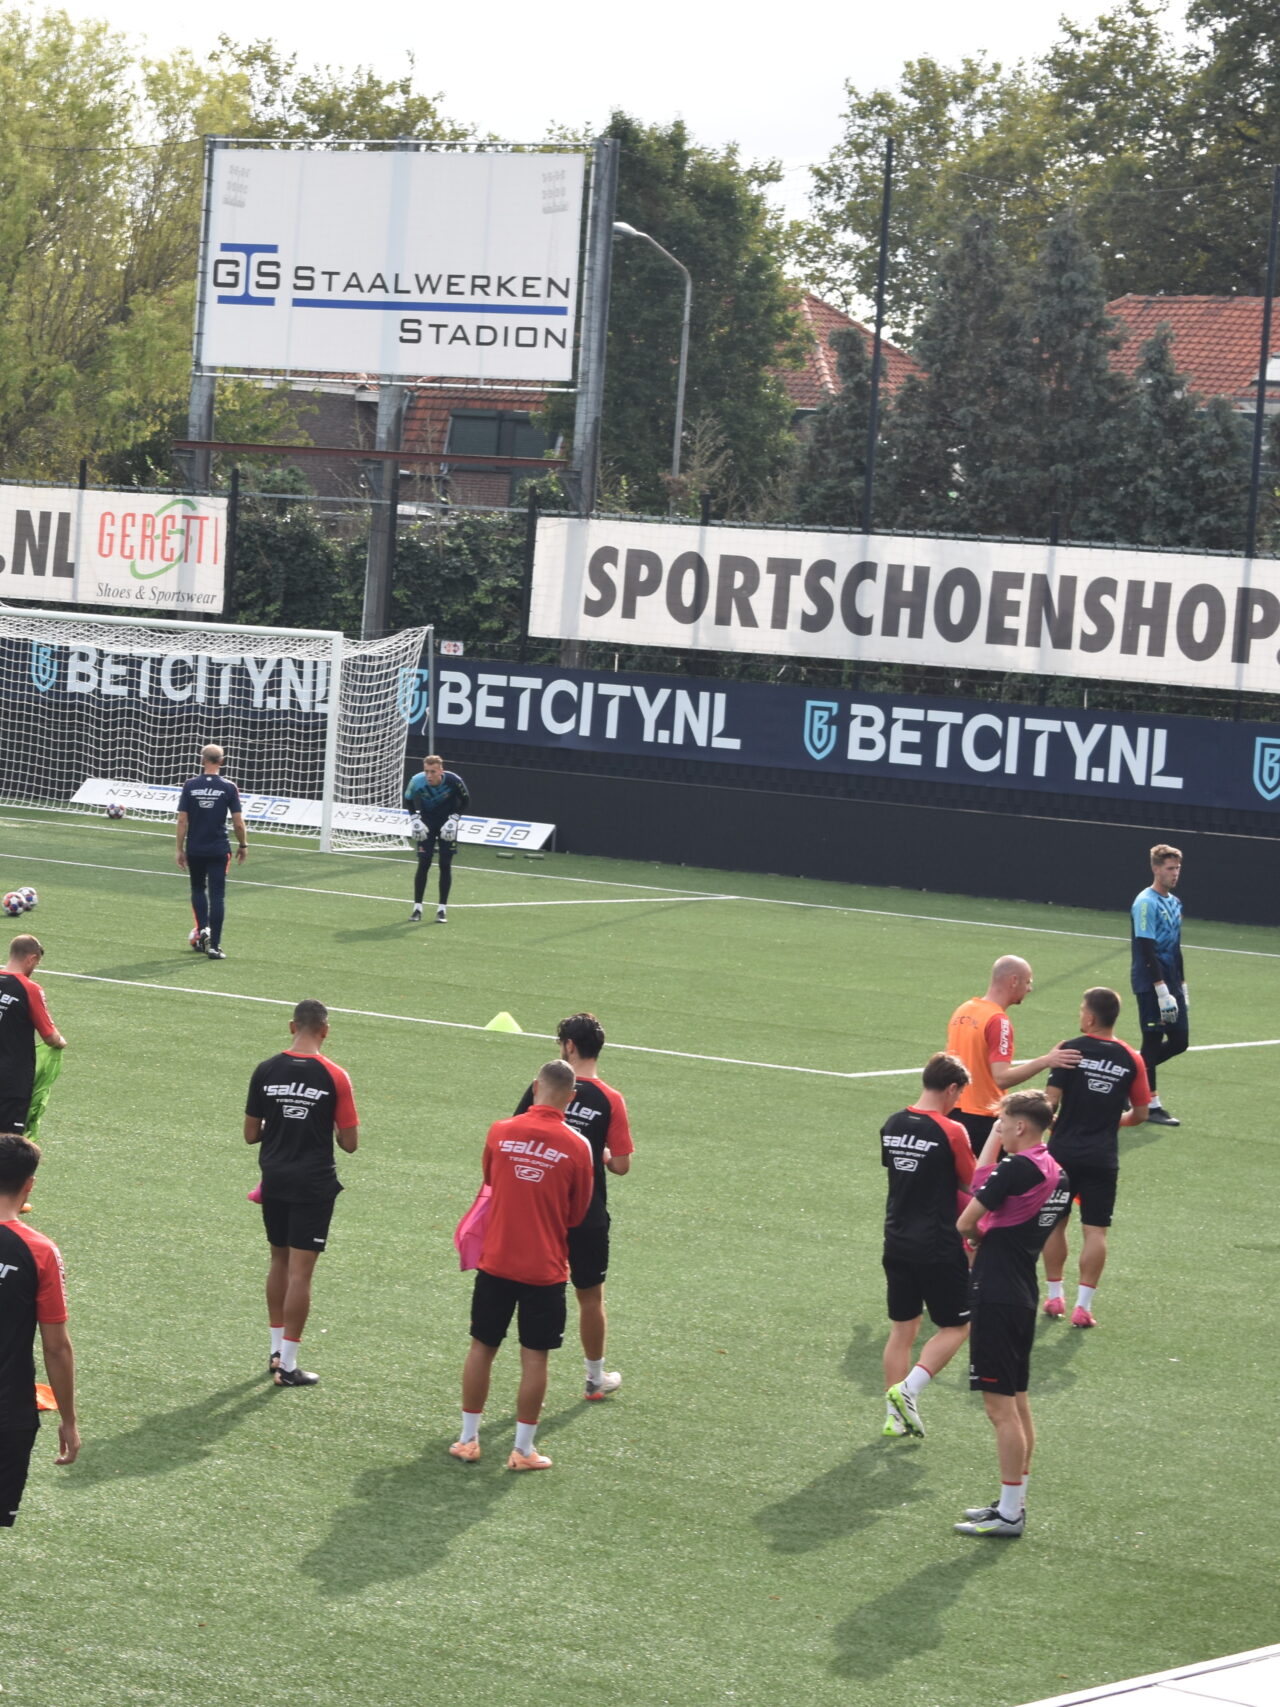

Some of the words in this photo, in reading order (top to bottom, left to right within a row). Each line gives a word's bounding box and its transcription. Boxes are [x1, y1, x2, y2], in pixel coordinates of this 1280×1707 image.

[293, 265, 570, 299] STAALWERKEN
[399, 318, 568, 349] STADION
[97, 511, 218, 565] GERETTI
[96, 582, 132, 599] Shoes
[135, 585, 145, 600] &
[149, 585, 217, 605] Sportswear
[583, 545, 1280, 664] SPORTSCHOENSHOP
[437, 670, 741, 750] BETCITY.NL
[847, 703, 1183, 789] BETCITY.NL
[190, 788, 225, 797] saller
[1078, 1058, 1130, 1077] saller
[263, 1082, 329, 1100] saller
[564, 1101, 602, 1121] ller
[499, 1140, 569, 1163] saller
[882, 1134, 939, 1151] saller
